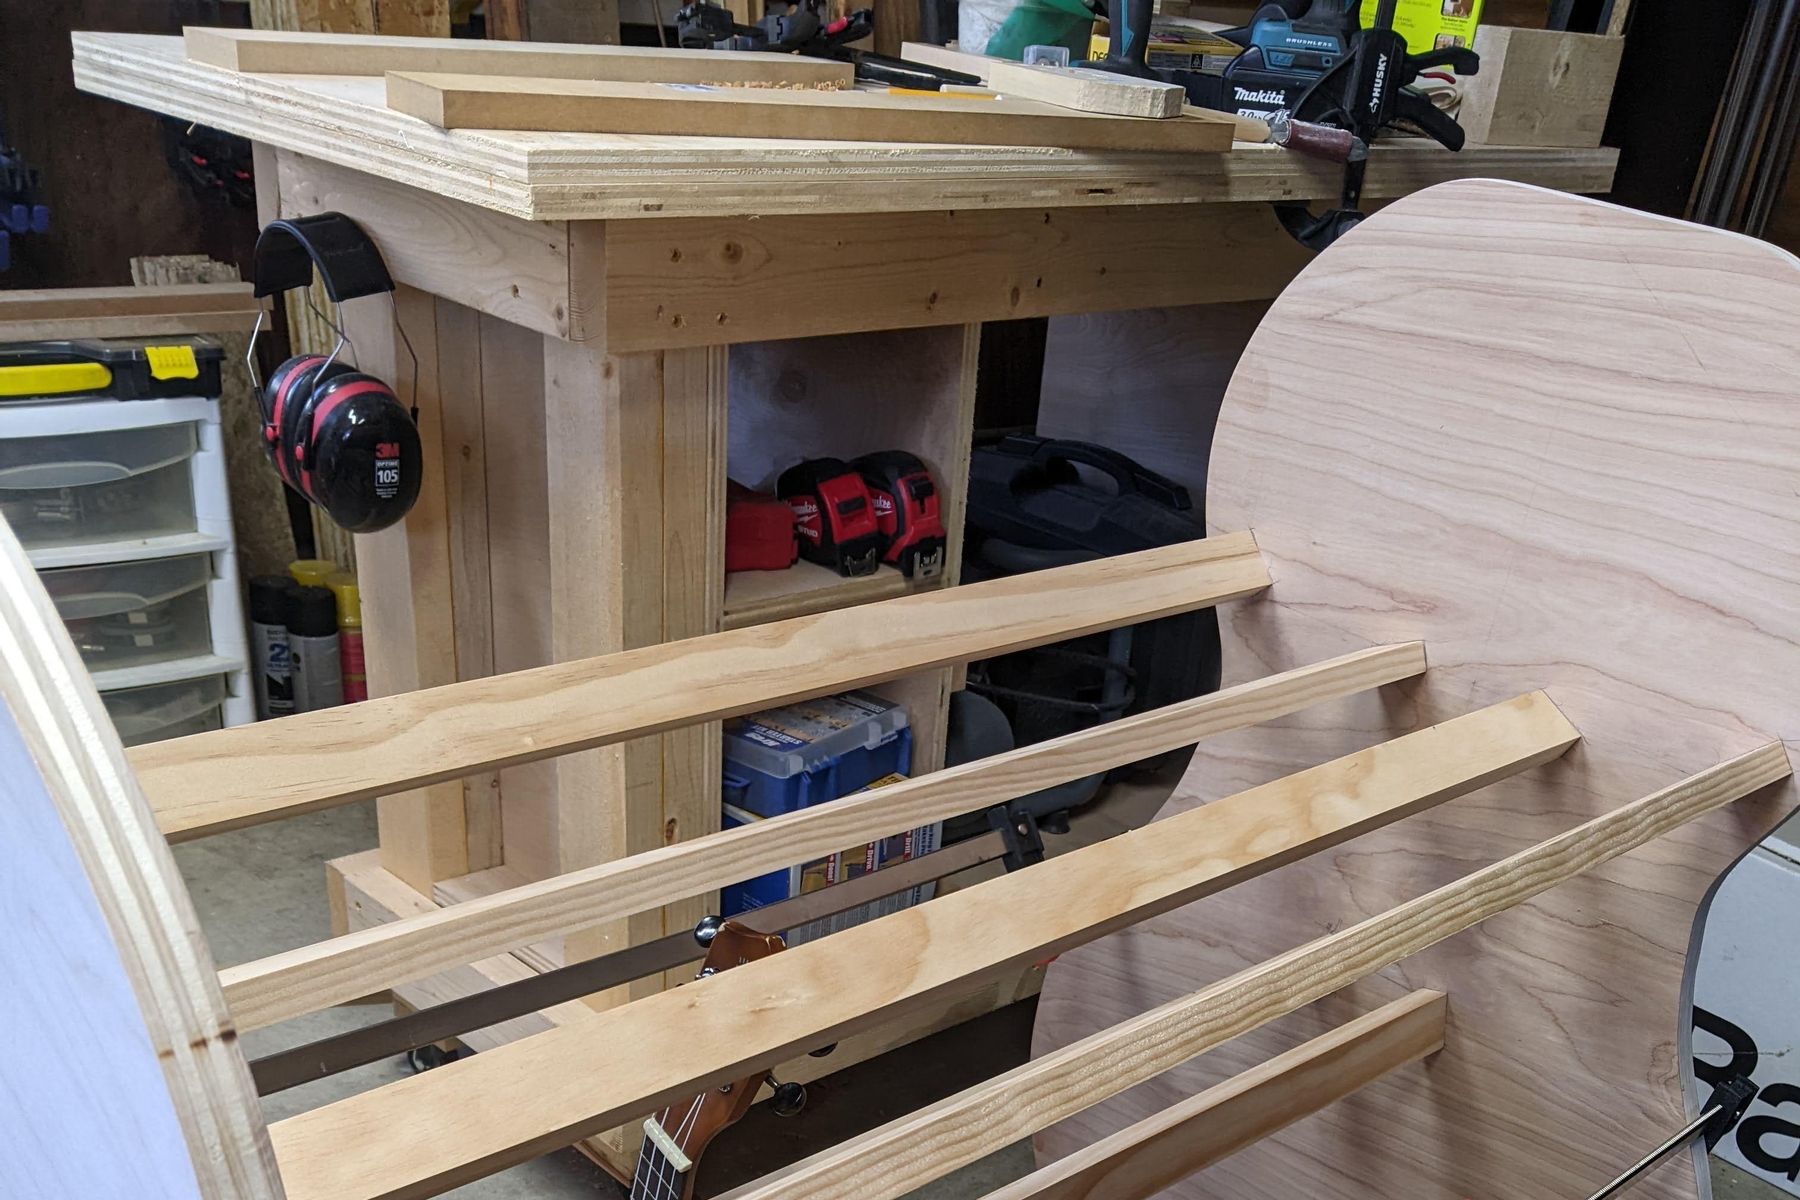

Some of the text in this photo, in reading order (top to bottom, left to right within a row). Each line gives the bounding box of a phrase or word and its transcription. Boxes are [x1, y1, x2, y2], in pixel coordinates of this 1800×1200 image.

[1372, 53, 1387, 97] HUSKY
[375, 443, 400, 458] 3M
[377, 469, 398, 483] 105
